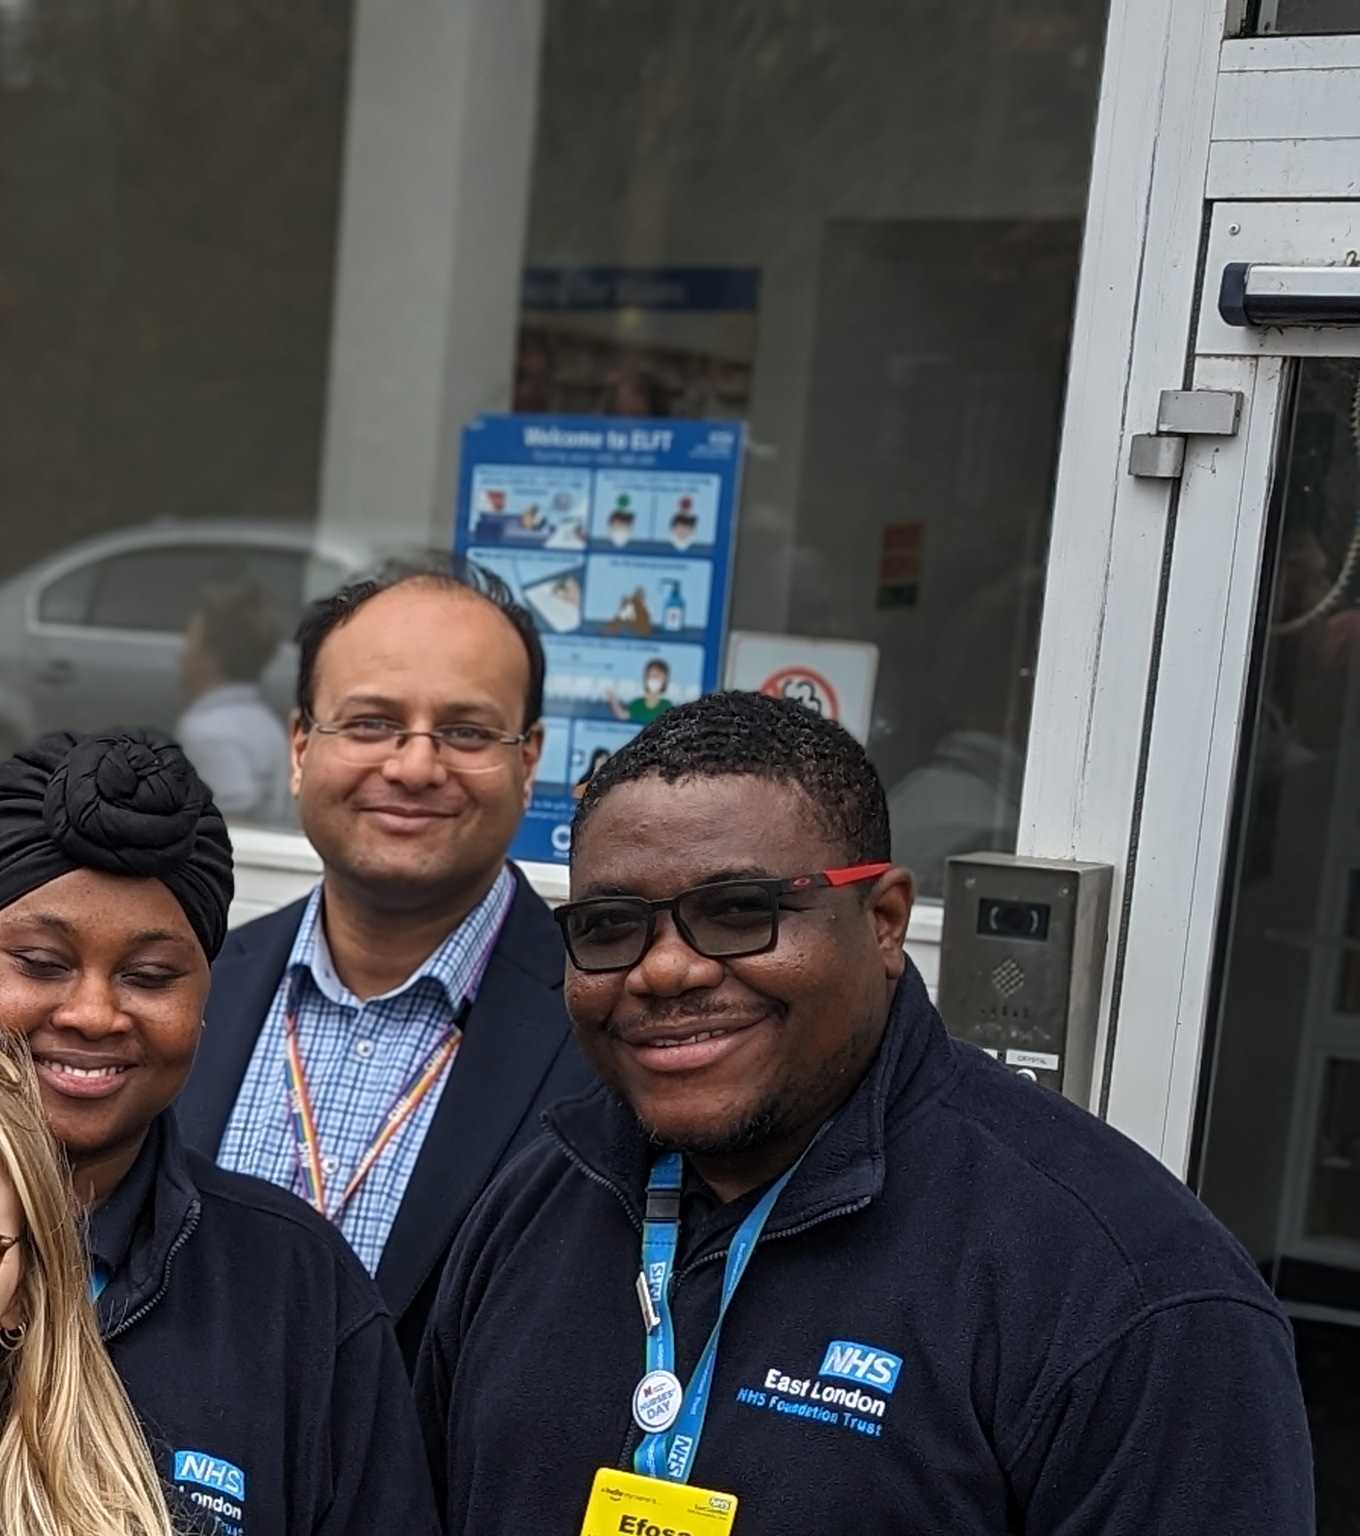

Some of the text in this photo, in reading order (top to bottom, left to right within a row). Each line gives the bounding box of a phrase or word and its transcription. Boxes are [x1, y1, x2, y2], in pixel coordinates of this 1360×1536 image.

[523, 426, 603, 450] Welcome
[607, 429, 628, 451] to
[631, 429, 675, 452] ELFT
[823, 1344, 898, 1387] NHS
[646, 1400, 671, 1420] DAY
[736, 1388, 883, 1437] NHS Foundation Trust
[764, 1368, 886, 1417] East London
[179, 1453, 242, 1495] NHS
[668, 1434, 692, 1478] NHS
[180, 1485, 242, 1520] ondon
